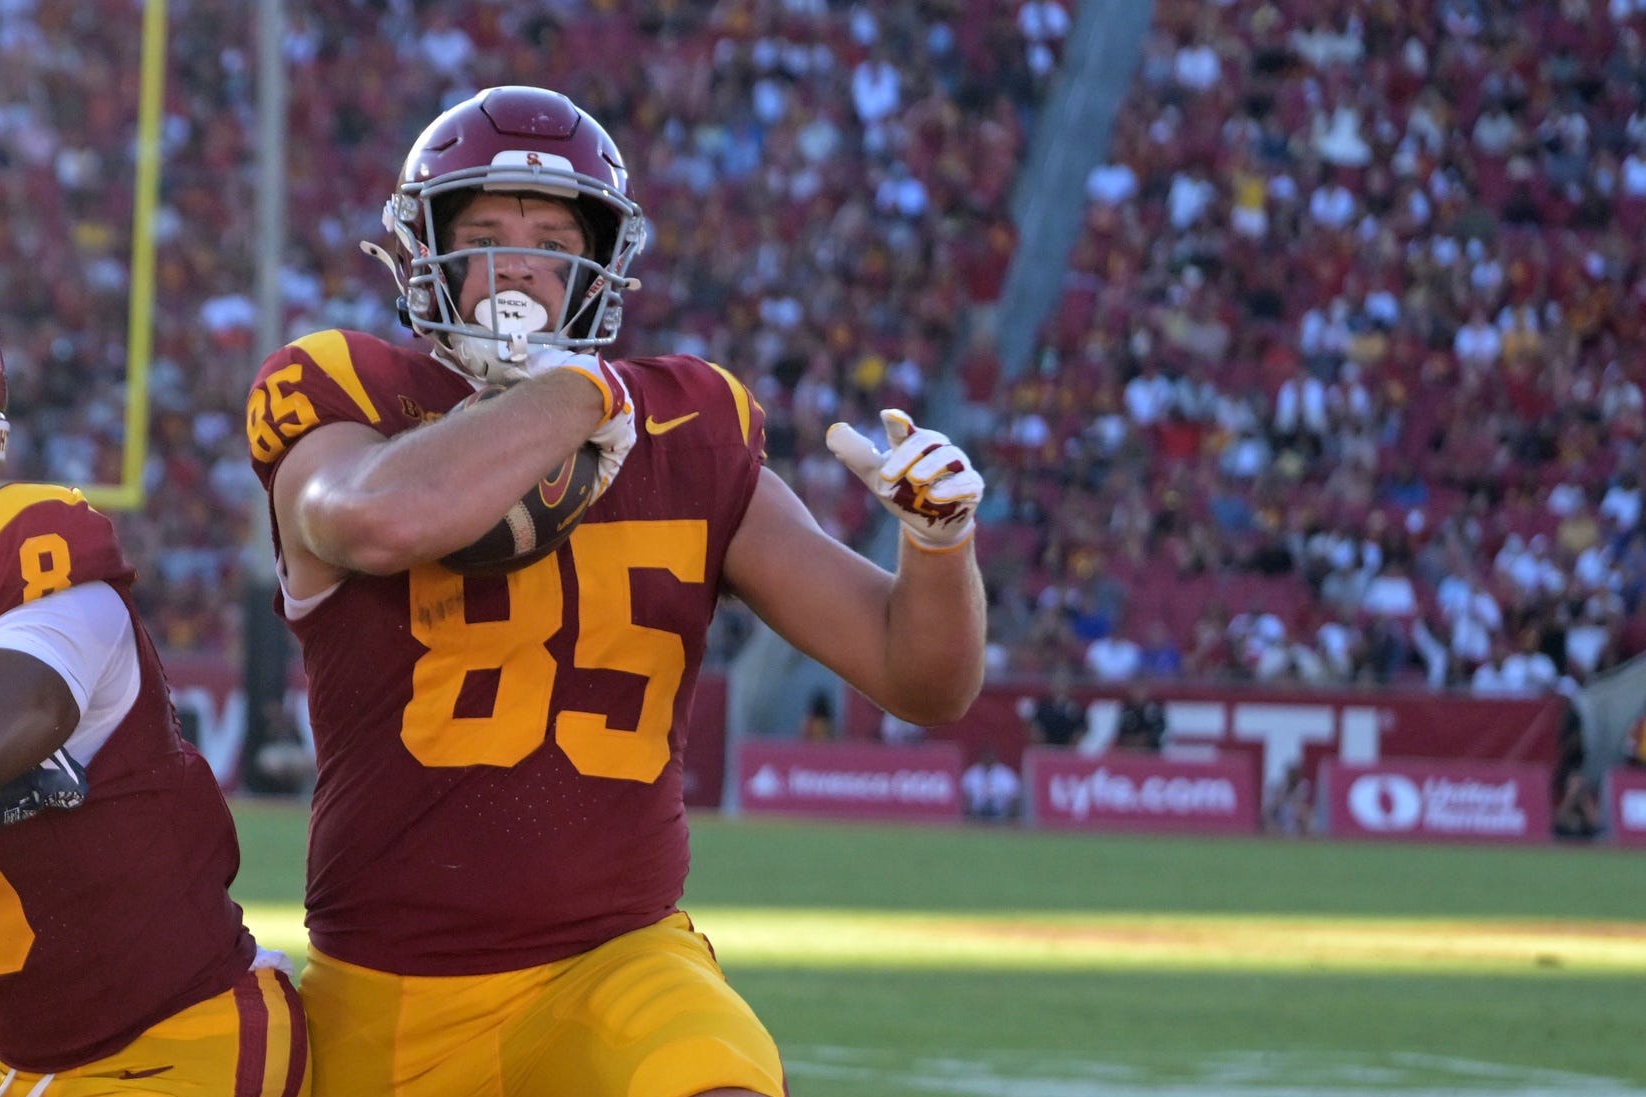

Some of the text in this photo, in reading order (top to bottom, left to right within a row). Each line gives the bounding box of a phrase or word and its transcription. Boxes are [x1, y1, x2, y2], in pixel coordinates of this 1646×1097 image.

[246, 363, 321, 463] 85
[19, 533, 72, 603] 8
[400, 519, 708, 785] 85
